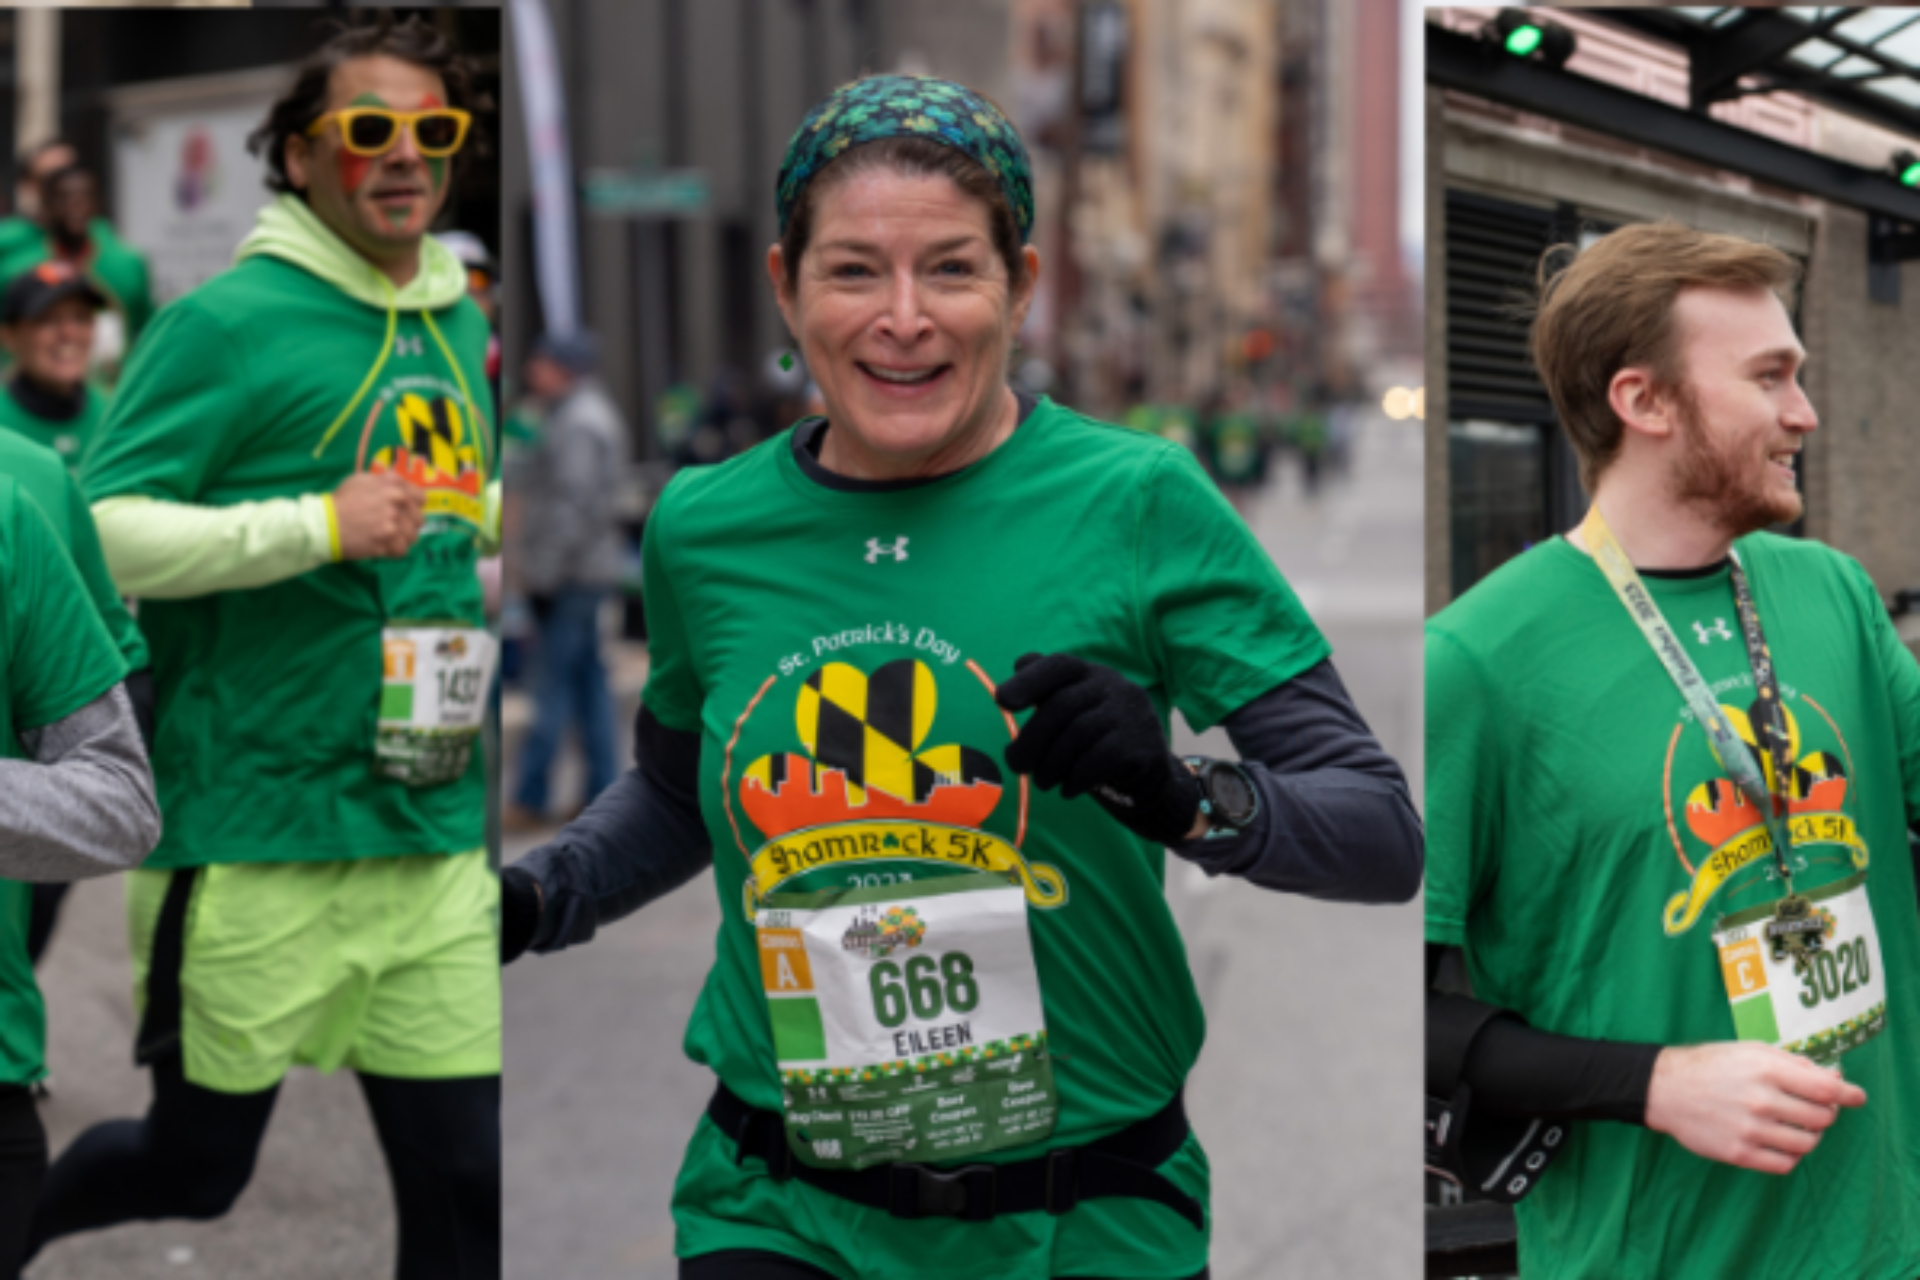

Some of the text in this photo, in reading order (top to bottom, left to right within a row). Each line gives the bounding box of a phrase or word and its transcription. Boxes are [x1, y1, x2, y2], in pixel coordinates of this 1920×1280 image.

[811, 620, 911, 657] Patrick's
[914, 627, 962, 665] Day
[948, 832, 994, 867] 5K
[776, 952, 798, 989] A
[1737, 960, 1755, 990] C
[1796, 936, 1870, 1009] 3020
[869, 951, 980, 1029] 668
[893, 1022, 973, 1058] EILEEN
